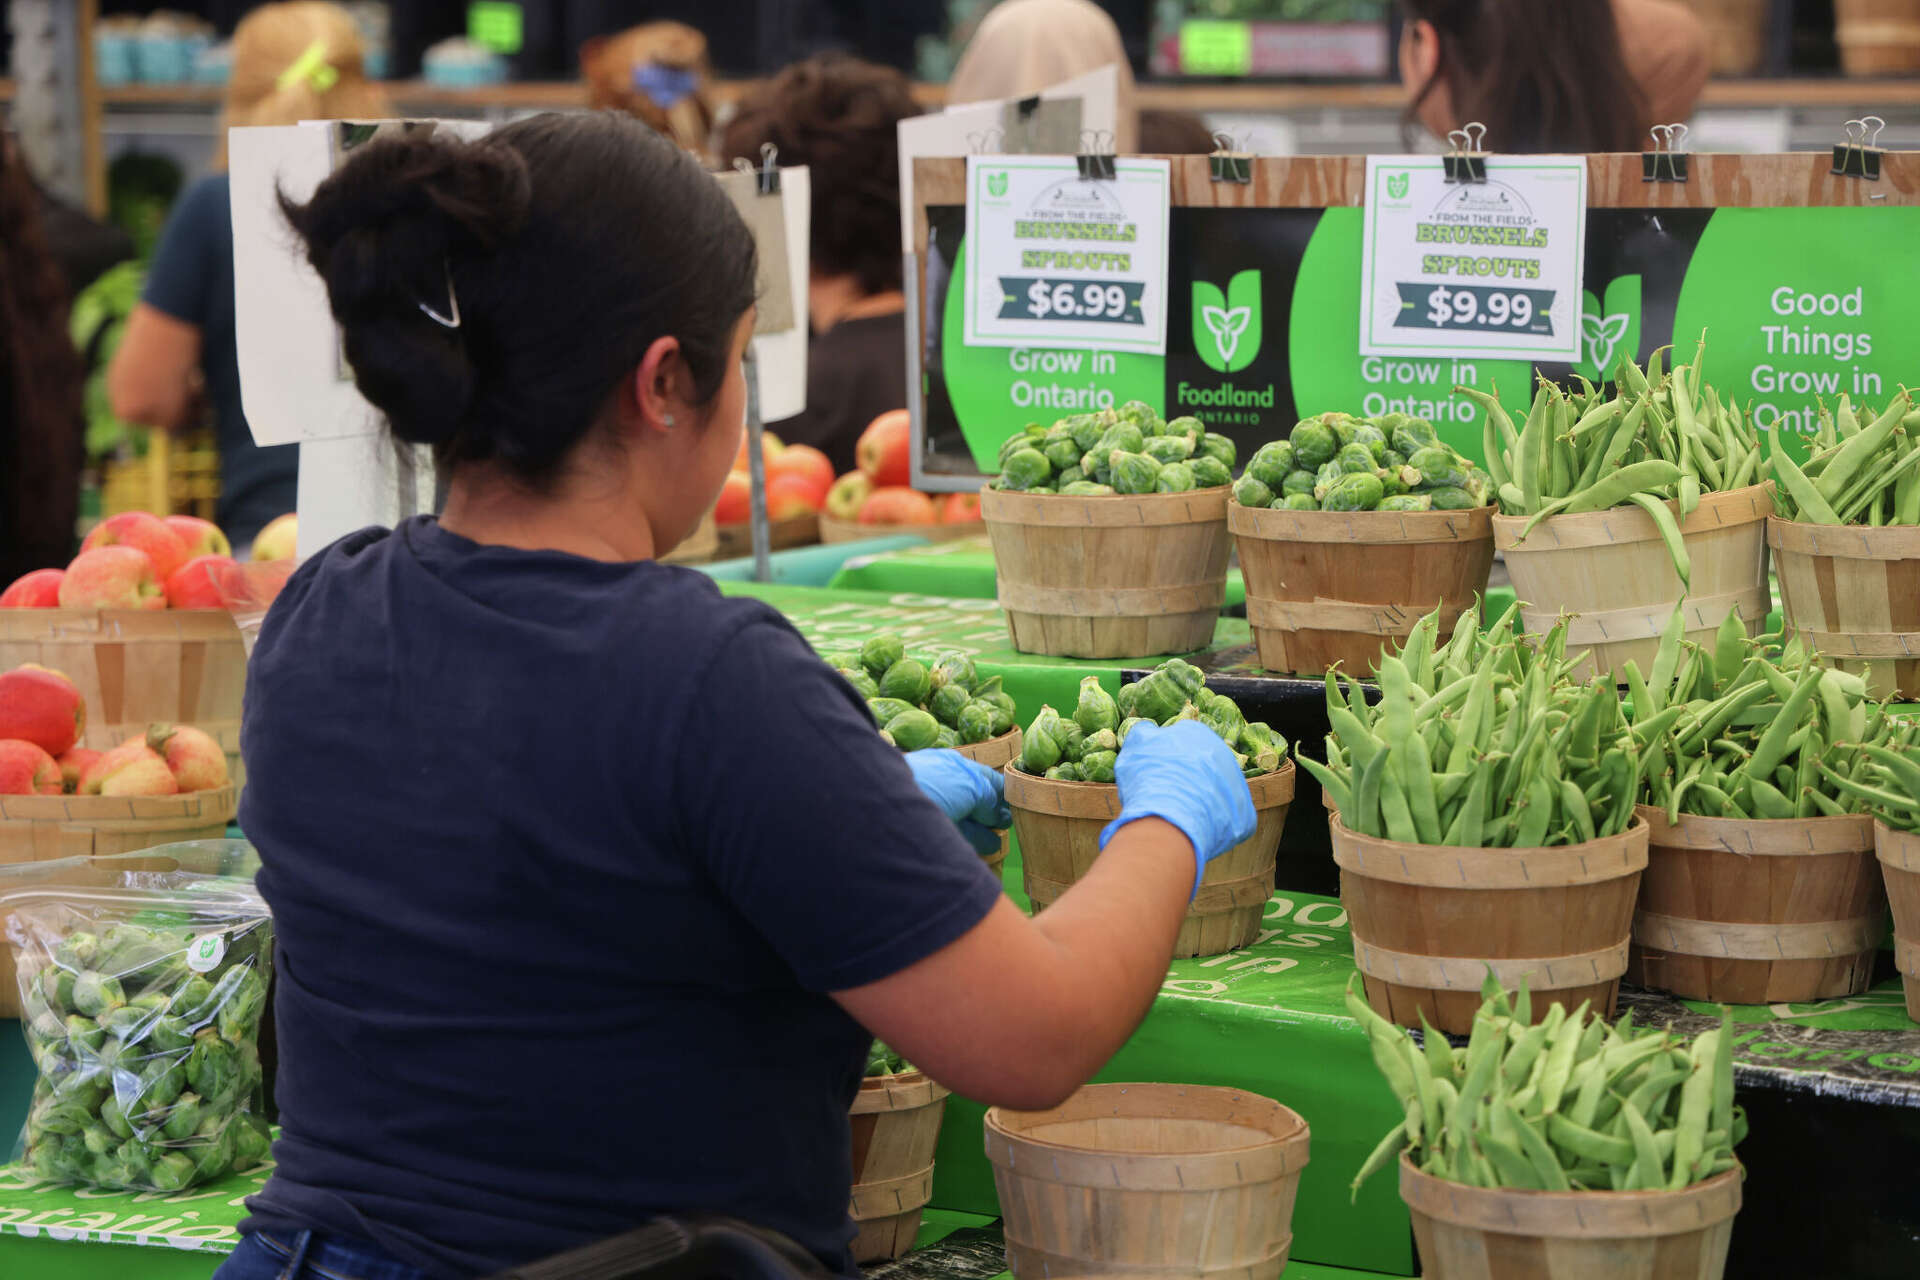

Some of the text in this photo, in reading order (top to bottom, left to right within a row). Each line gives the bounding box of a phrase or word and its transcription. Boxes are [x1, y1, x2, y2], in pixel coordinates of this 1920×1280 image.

[1033, 211, 1123, 221] FROM THE FIELDS
[1436, 213, 1532, 226] FROM THE FIELDS
[1014, 220, 1137, 242] BRUSSELS
[1416, 223, 1548, 248] BRUSSELS
[1021, 250, 1131, 272] SPROUTS
[1422, 255, 1540, 279] SPROUTS
[1027, 280, 1126, 319] $6.99
[1427, 285, 1532, 327] $9.99
[1770, 286, 1862, 317] Good
[1760, 325, 1872, 362] Things
[1009, 349, 1116, 375] Grow in
[1361, 357, 1477, 385] Grow in
[1750, 364, 1882, 396] Grow in
[1010, 380, 1115, 409] Ontario
[1177, 381, 1274, 408] Foodland
[1362, 390, 1476, 422] Ontario
[1193, 410, 1260, 425] ONTARIO
